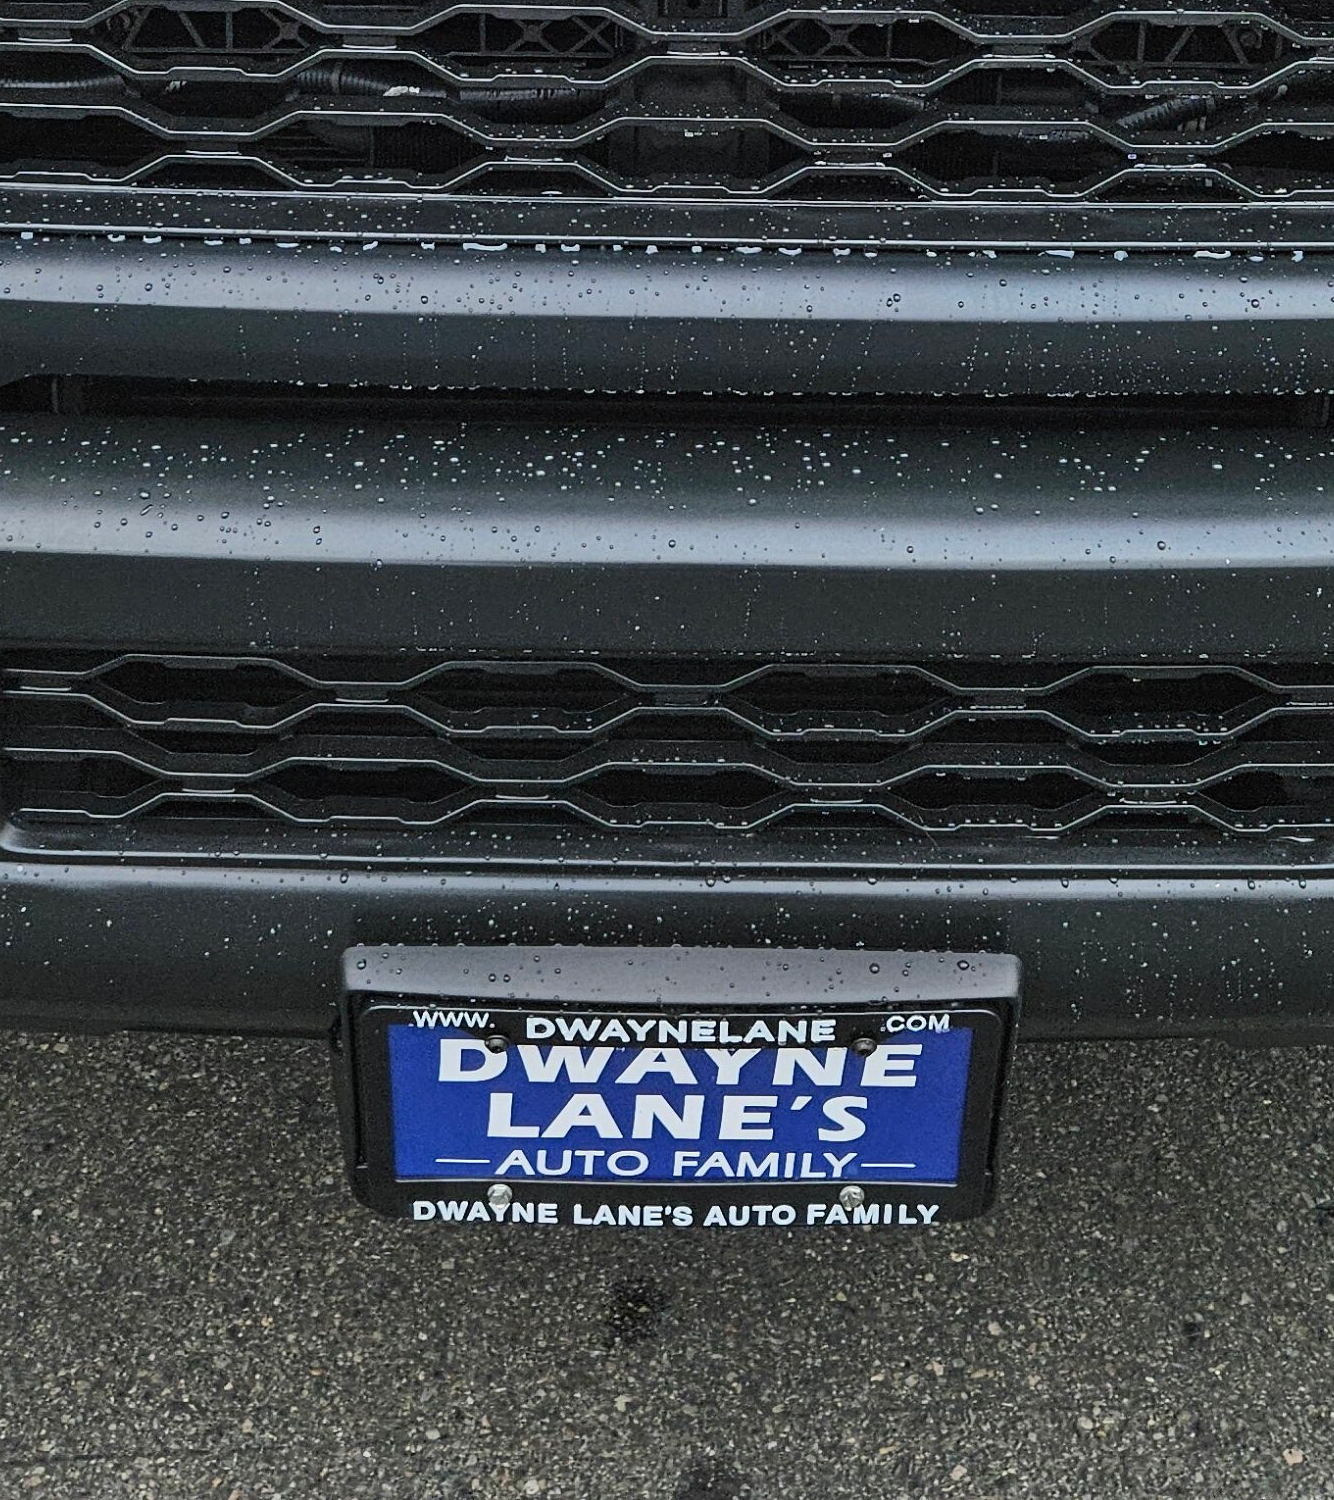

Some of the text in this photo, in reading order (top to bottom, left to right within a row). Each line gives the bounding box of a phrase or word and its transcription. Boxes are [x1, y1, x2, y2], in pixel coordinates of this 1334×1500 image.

[525, 1016, 837, 1044] DWAYNELANE
[438, 1038, 923, 1087] DWAYNE
[487, 1092, 868, 1142] LANE'S
[494, 1149, 858, 1178] AUTO FAMILY
[412, 1200, 940, 1227] DWAYNE LANE'S AUTO FAMILY
